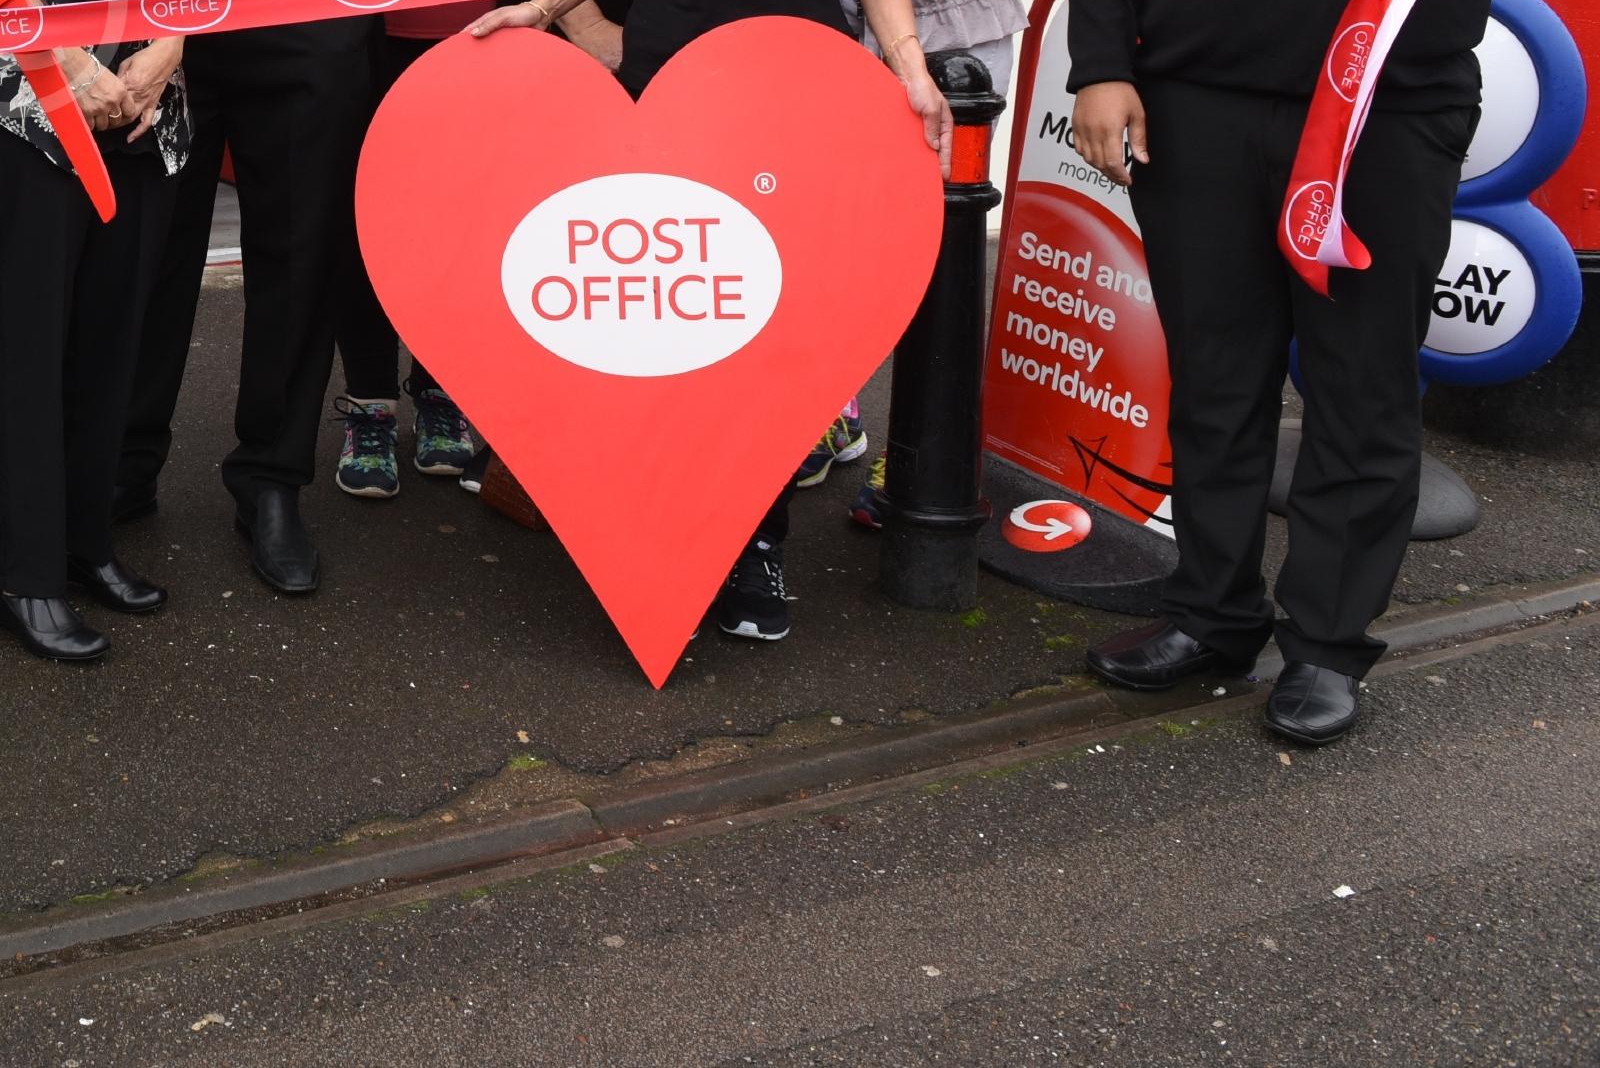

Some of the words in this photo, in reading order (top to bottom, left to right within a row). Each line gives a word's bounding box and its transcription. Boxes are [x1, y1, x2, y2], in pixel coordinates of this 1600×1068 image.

[1341, 31, 1368, 90] OFFICE
[567, 218, 720, 264] POST
[1298, 189, 1325, 247] OFFICE
[1018, 232, 1092, 281] Send
[531, 275, 746, 321] OFFICE
[1012, 274, 1116, 331] receive
[1431, 291, 1505, 326] OW
[1006, 311, 1104, 373] money
[1001, 347, 1149, 428] worldwide
